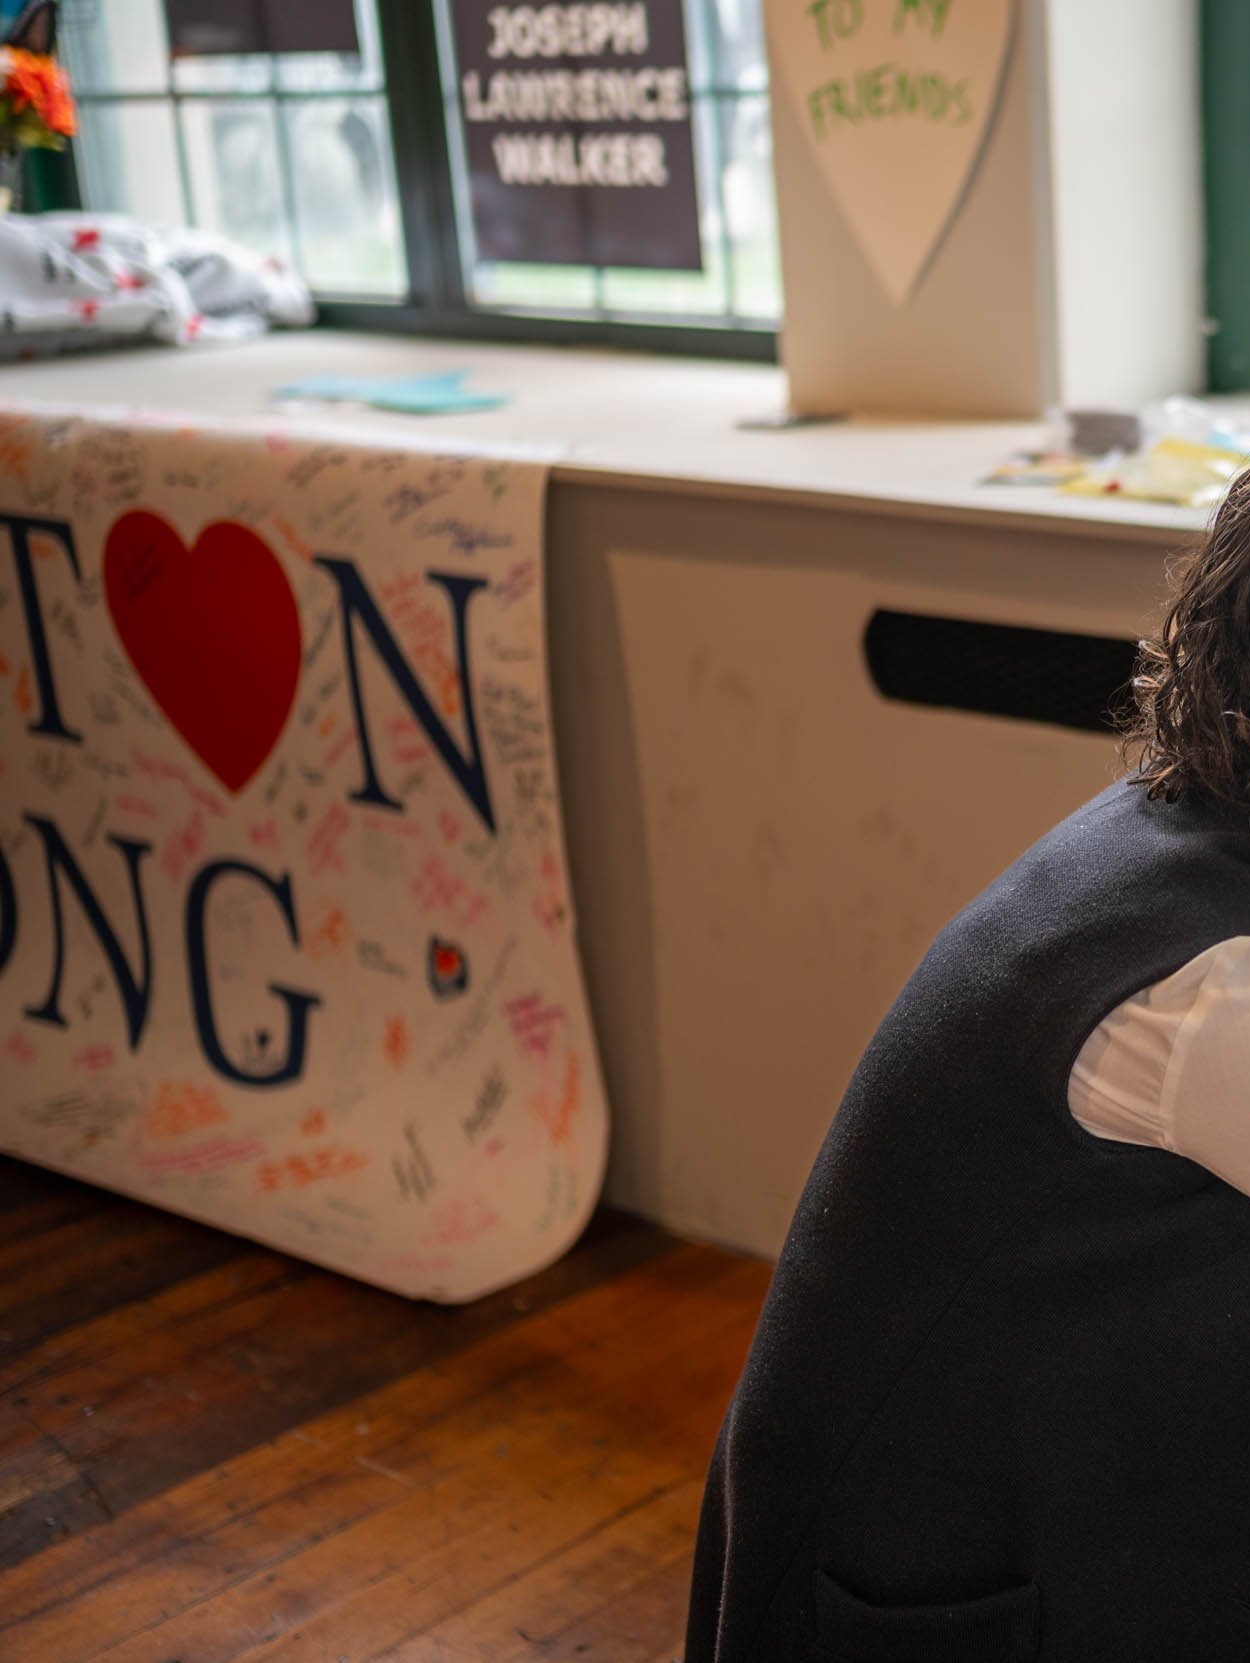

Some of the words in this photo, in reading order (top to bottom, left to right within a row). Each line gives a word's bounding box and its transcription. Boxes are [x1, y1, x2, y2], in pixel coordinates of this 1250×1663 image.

[488, 4, 648, 58] JOSEPH
[805, 0, 864, 52] TO
[463, 68, 687, 121] LAWRENCE
[807, 62, 973, 143] FRIENDS
[492, 132, 668, 187] WALKER
[0, 811, 322, 1092] NG
